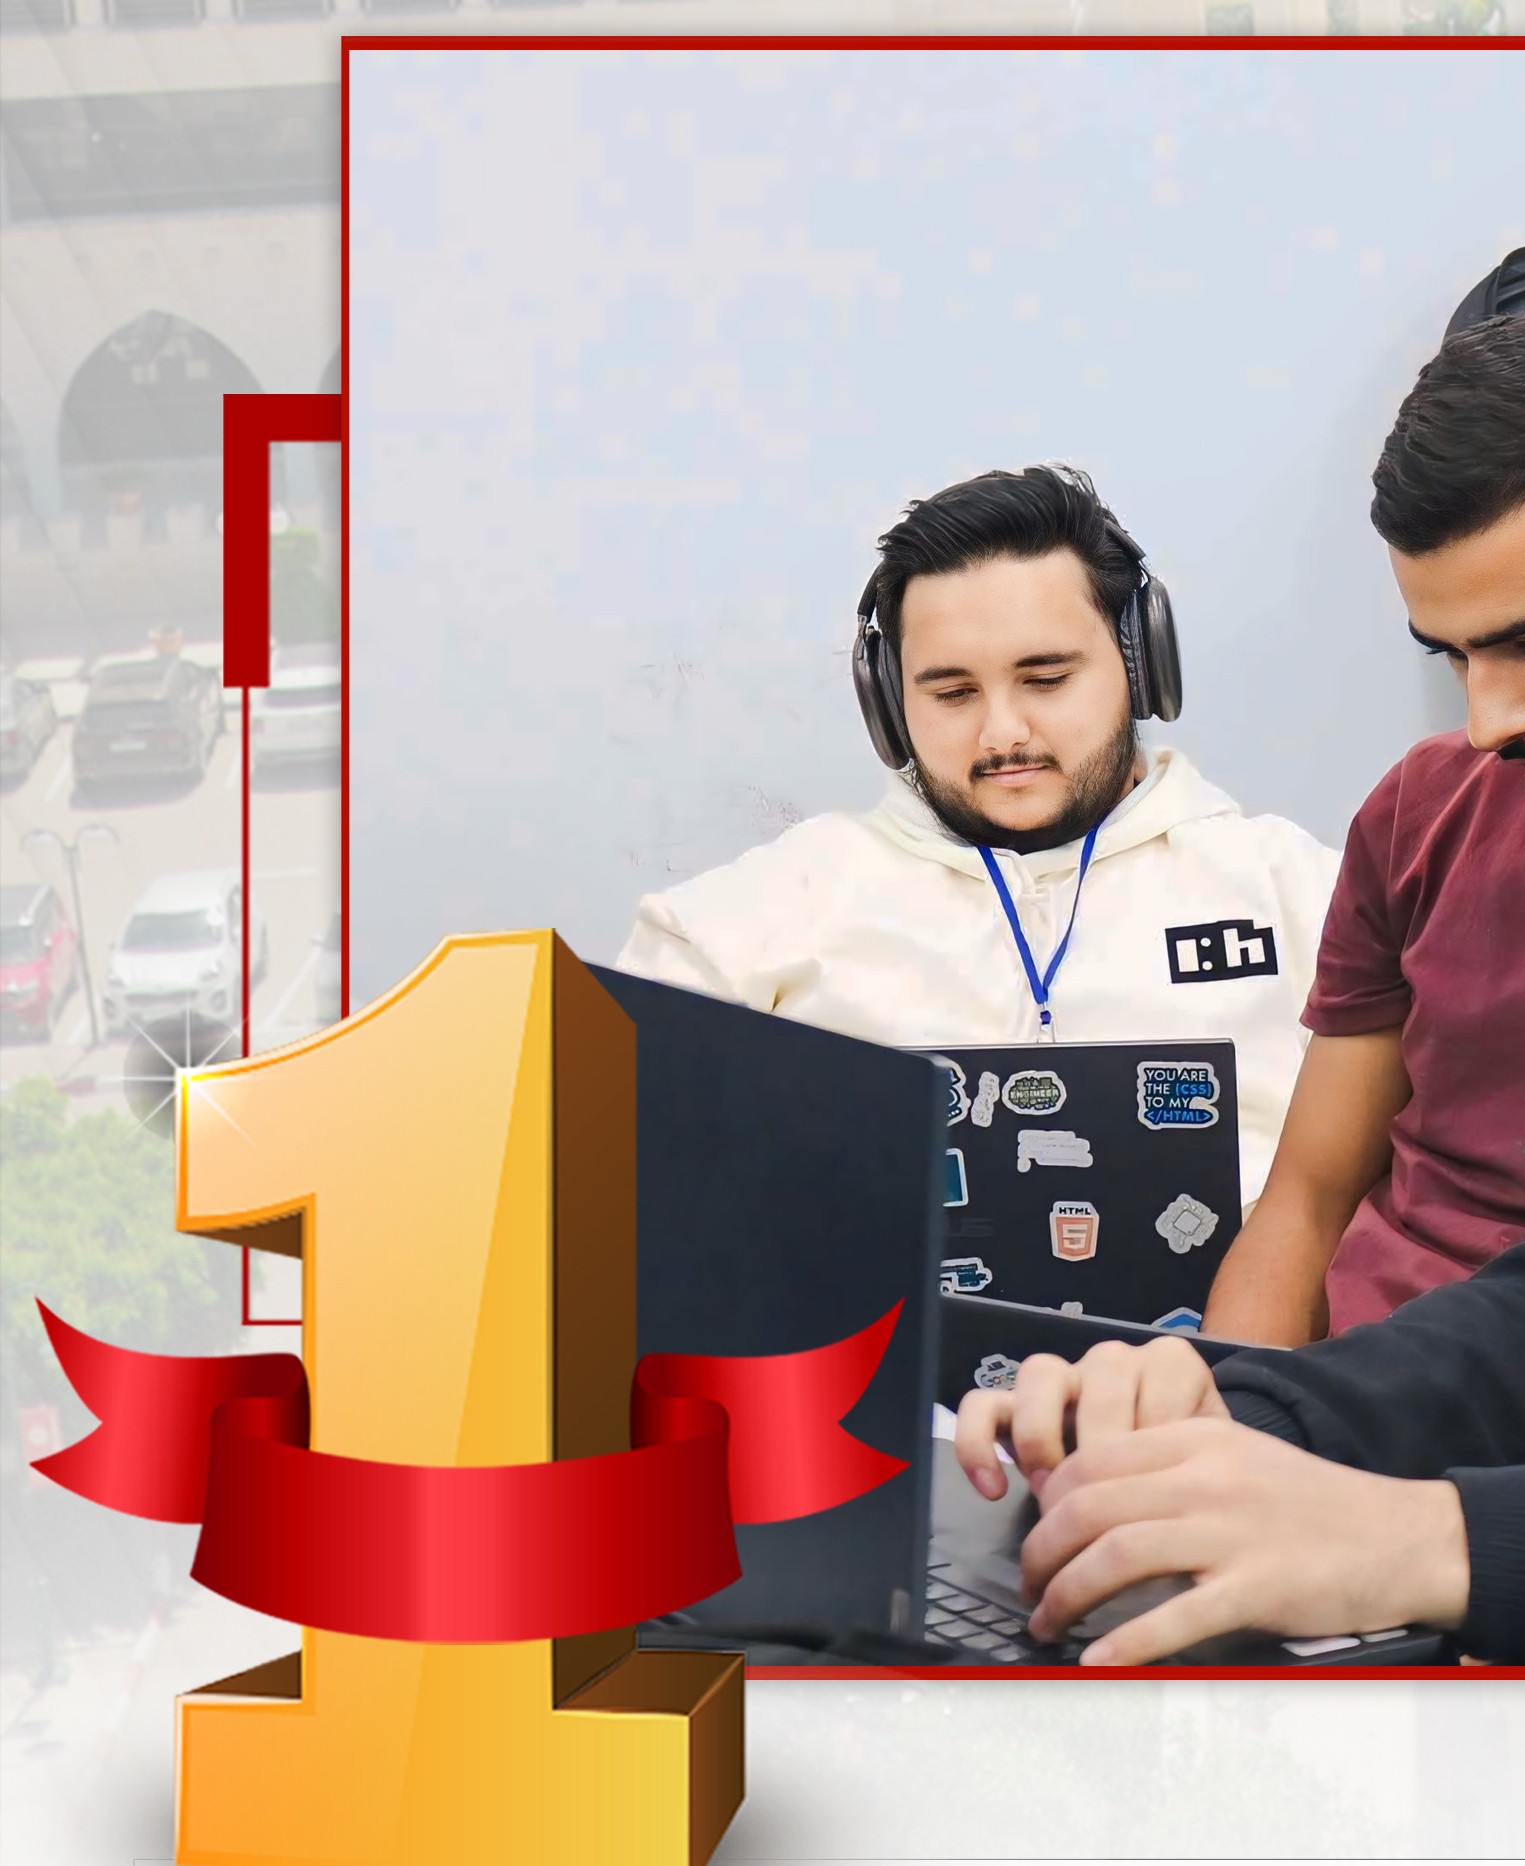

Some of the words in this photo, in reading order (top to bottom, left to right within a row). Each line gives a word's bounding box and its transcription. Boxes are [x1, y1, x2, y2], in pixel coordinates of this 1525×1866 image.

[1145, 1069, 1176, 1081] YOU
[1180, 1070, 1207, 1082] ARE
[1145, 1083, 1171, 1095] THE
[1145, 1096, 1164, 1108] TO
[1169, 1097, 1190, 1108] MY
[1146, 1109, 1211, 1123] </HTML>
[1059, 1206, 1092, 1216] HTML
